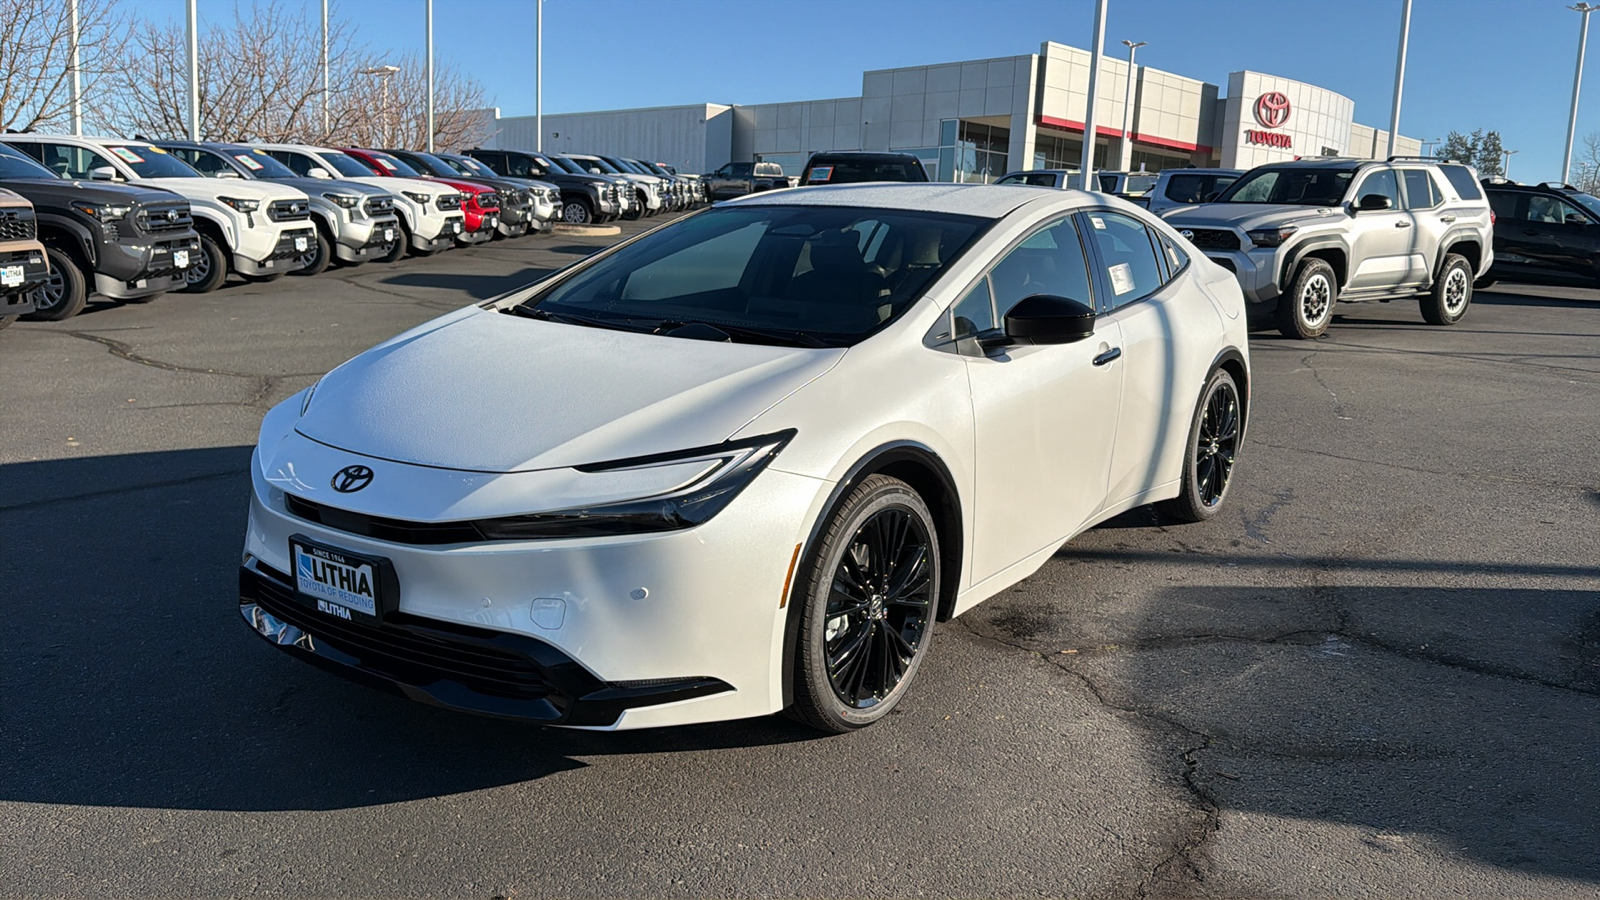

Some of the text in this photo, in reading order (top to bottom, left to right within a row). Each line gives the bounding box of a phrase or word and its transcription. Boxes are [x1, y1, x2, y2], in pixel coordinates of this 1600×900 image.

[1247, 129, 1292, 148] TOYOTA
[313, 548, 345, 563] SINCE 1946
[312, 558, 372, 597] LITHIA
[300, 578, 374, 609] TOYOTA OF REDDING
[325, 602, 352, 620] LITHIA
